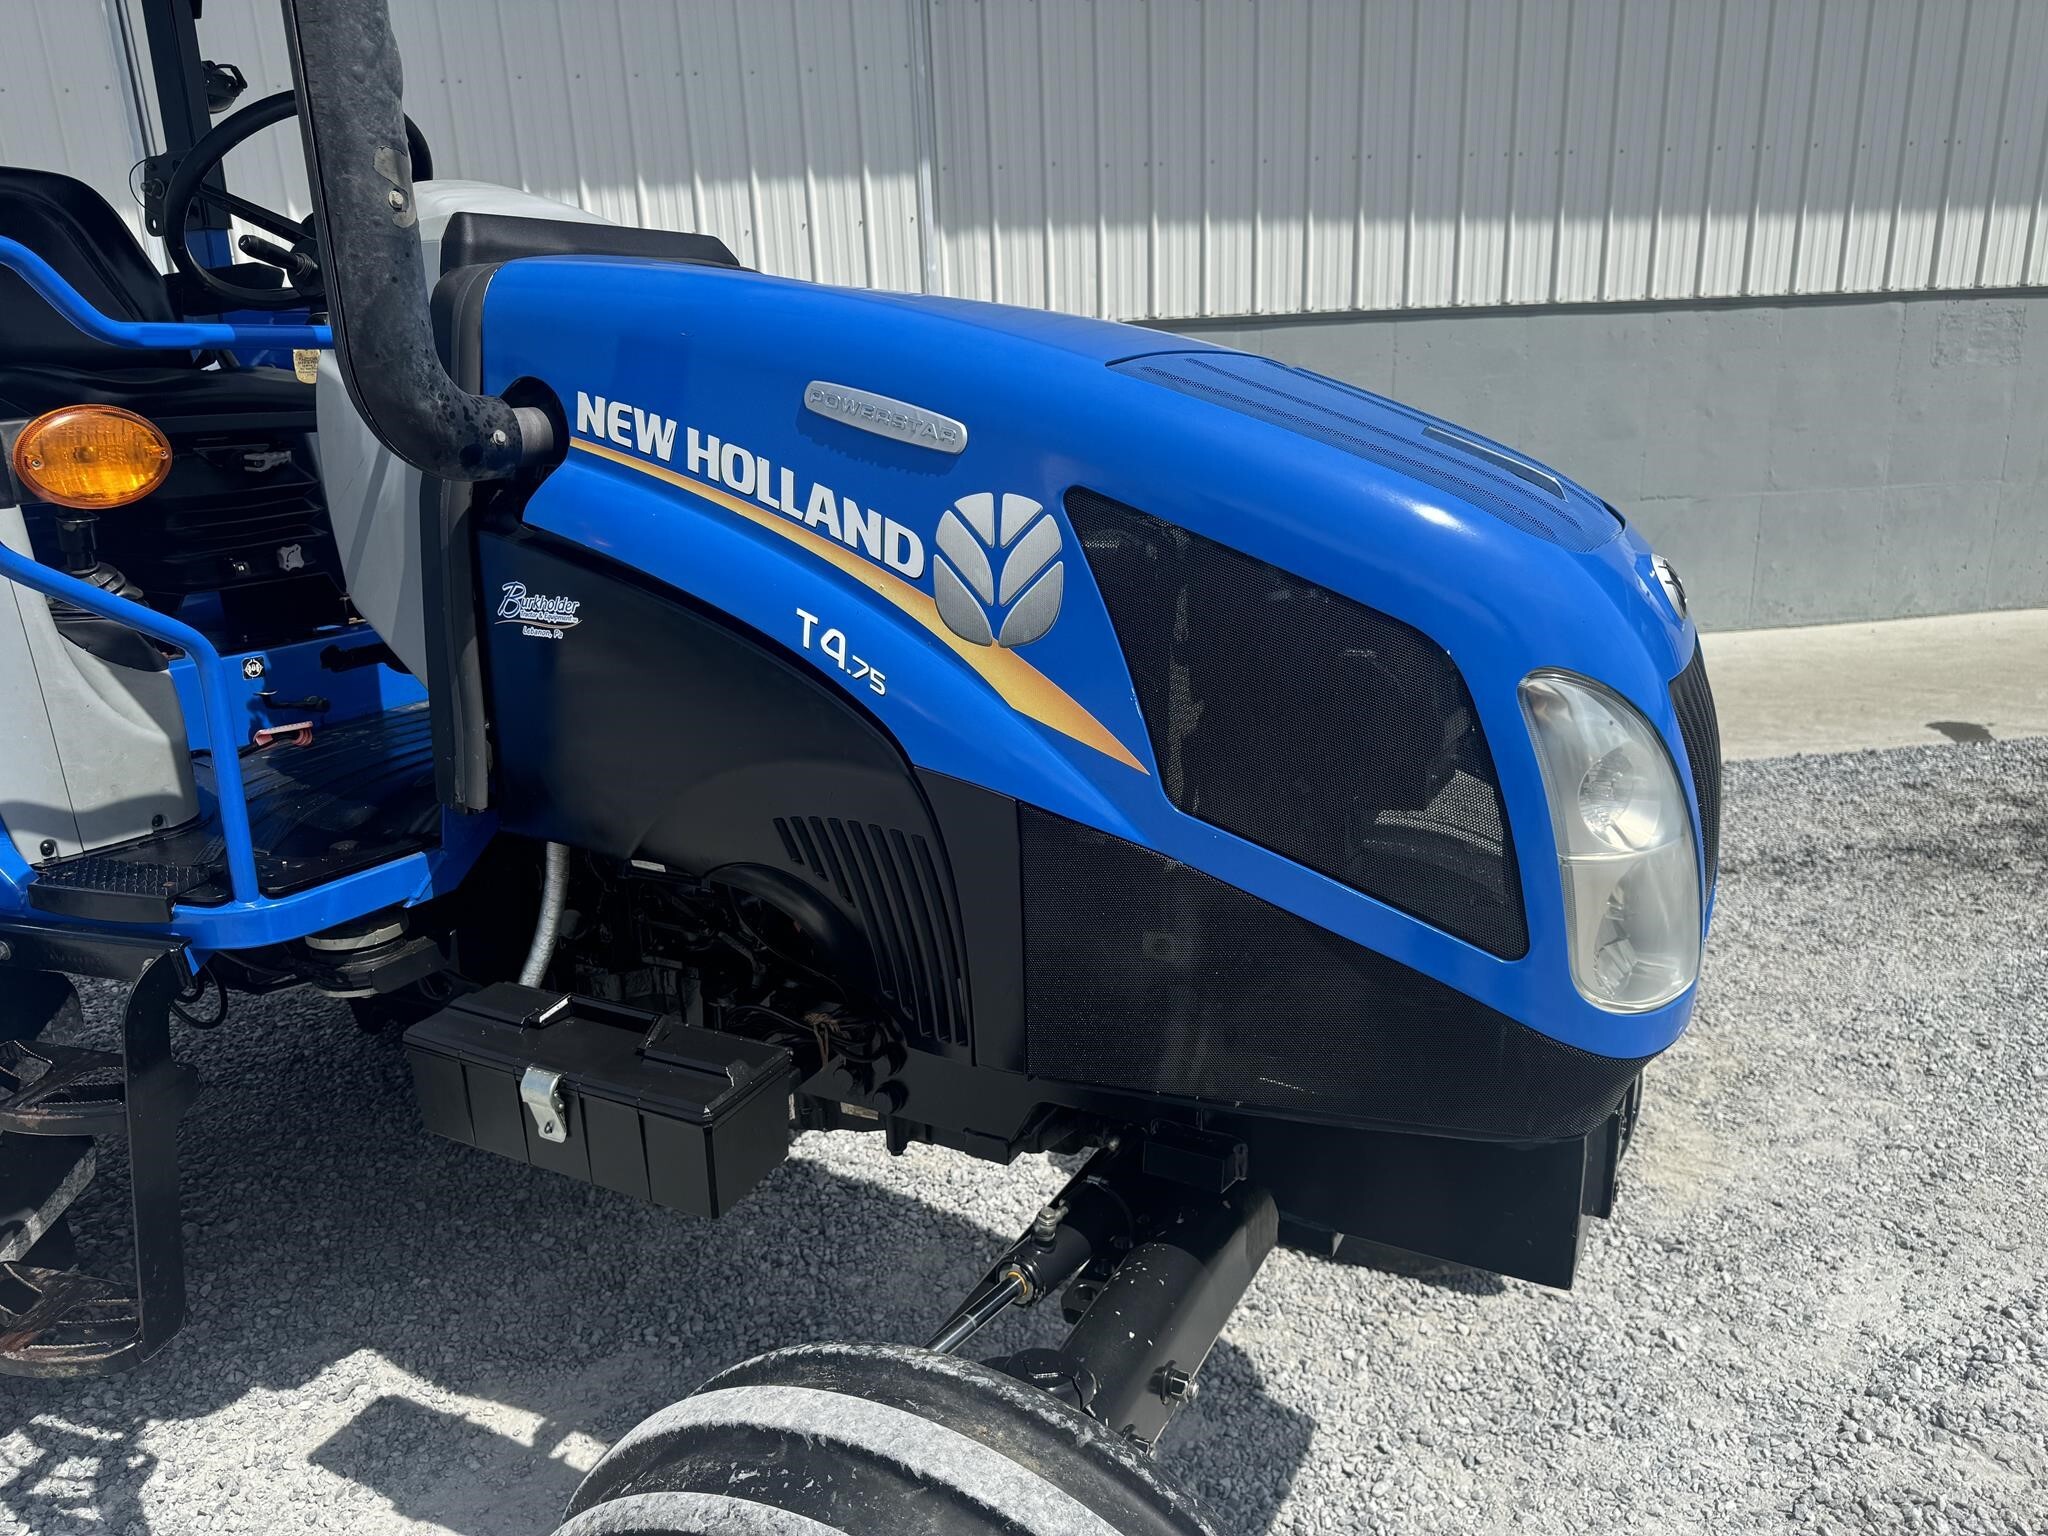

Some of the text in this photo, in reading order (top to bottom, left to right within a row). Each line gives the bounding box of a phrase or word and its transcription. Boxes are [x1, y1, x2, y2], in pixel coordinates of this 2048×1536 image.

[809, 388, 957, 446] POWERSTAR
[577, 391, 925, 579] NEW HOLLAND
[498, 581, 580, 618] Burkholder
[520, 609, 538, 619] Tractor
[538, 610, 544, 620] &
[522, 626, 552, 638] Lebanon,
